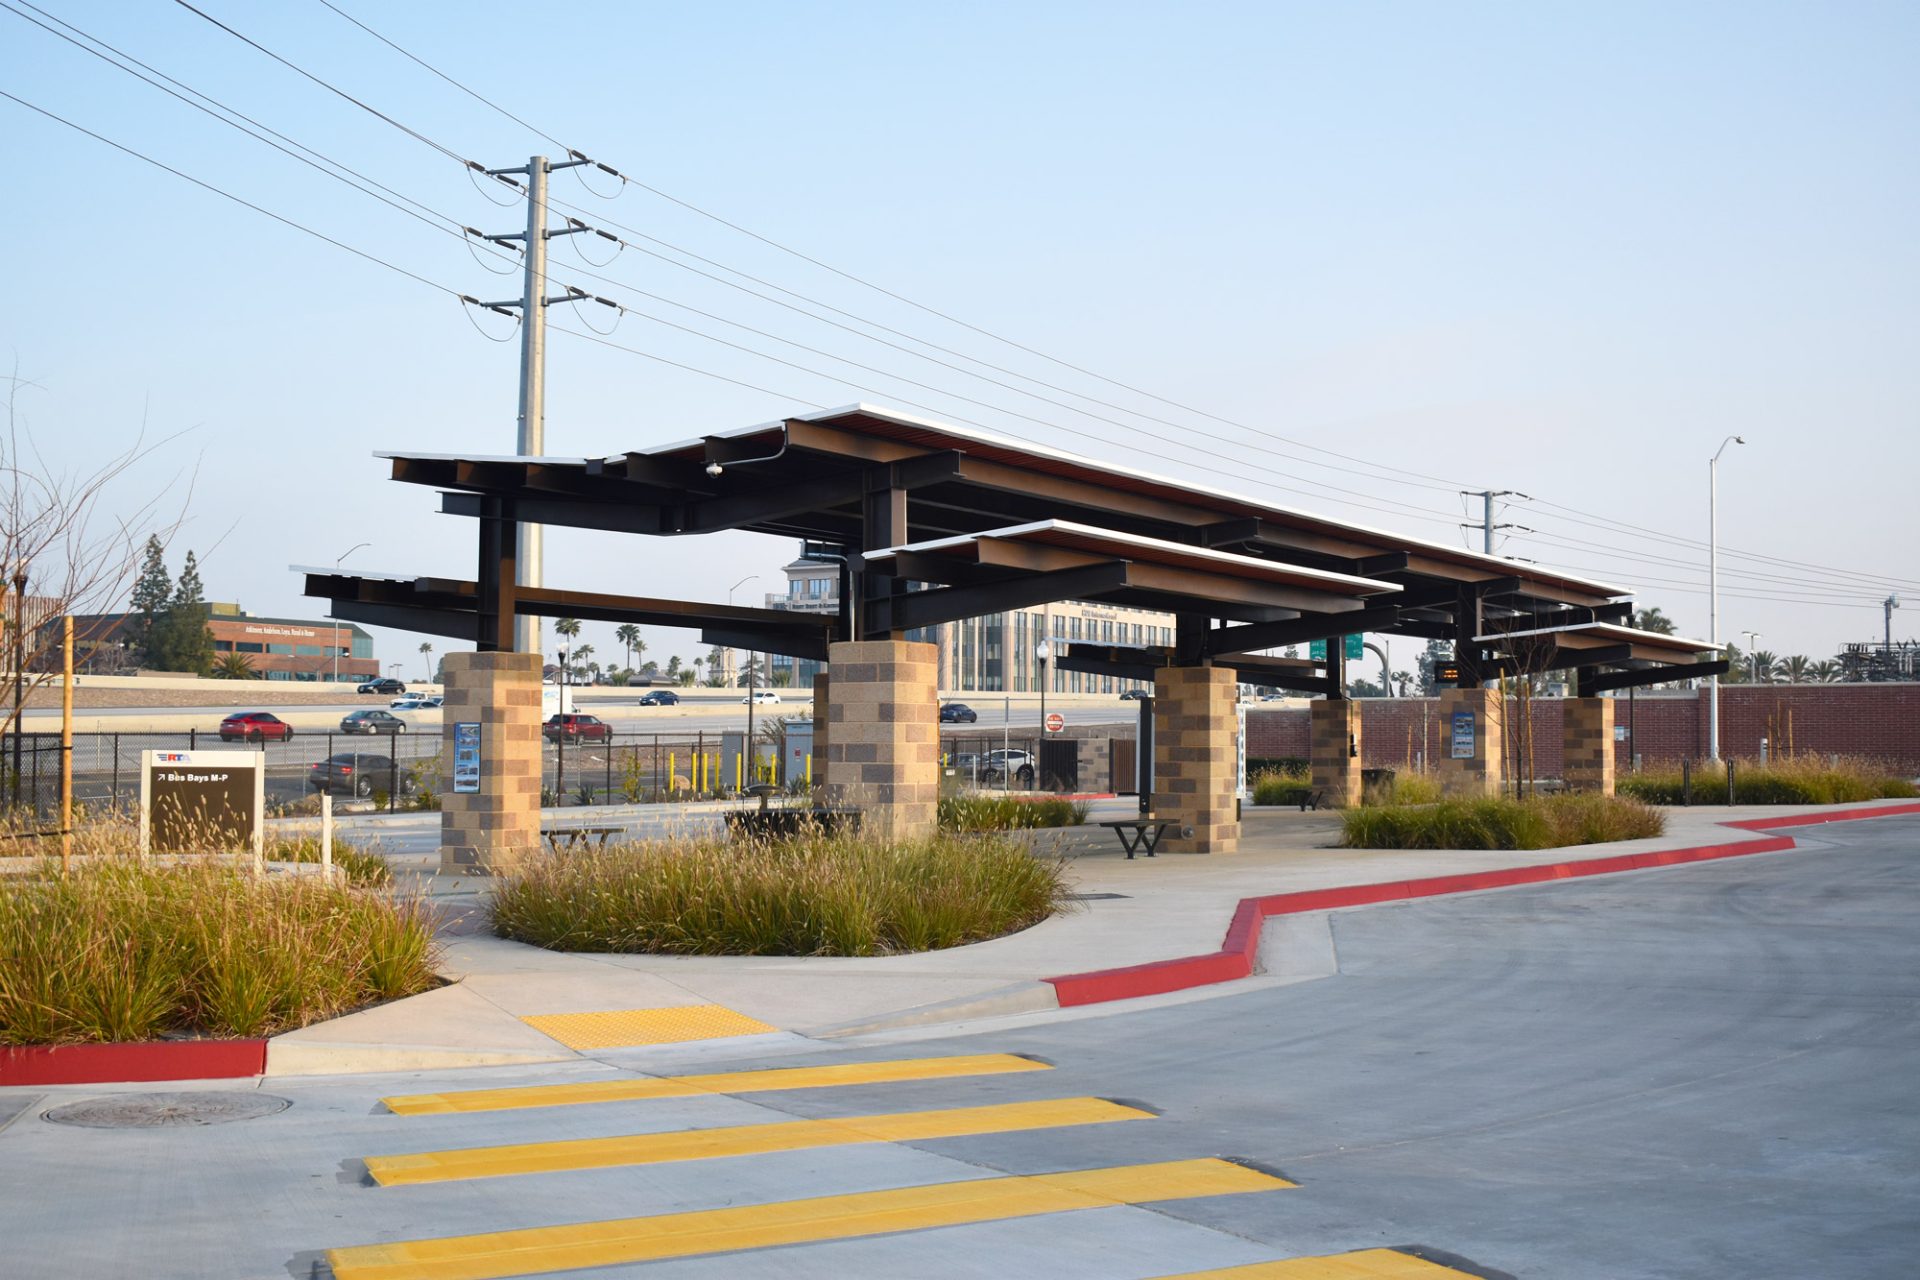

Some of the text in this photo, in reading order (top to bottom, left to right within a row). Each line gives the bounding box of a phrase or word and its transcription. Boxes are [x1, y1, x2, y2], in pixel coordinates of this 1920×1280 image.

[168, 754, 191, 763] RTA
[187, 773, 209, 783] Bays
[210, 774, 228, 782] M-P
